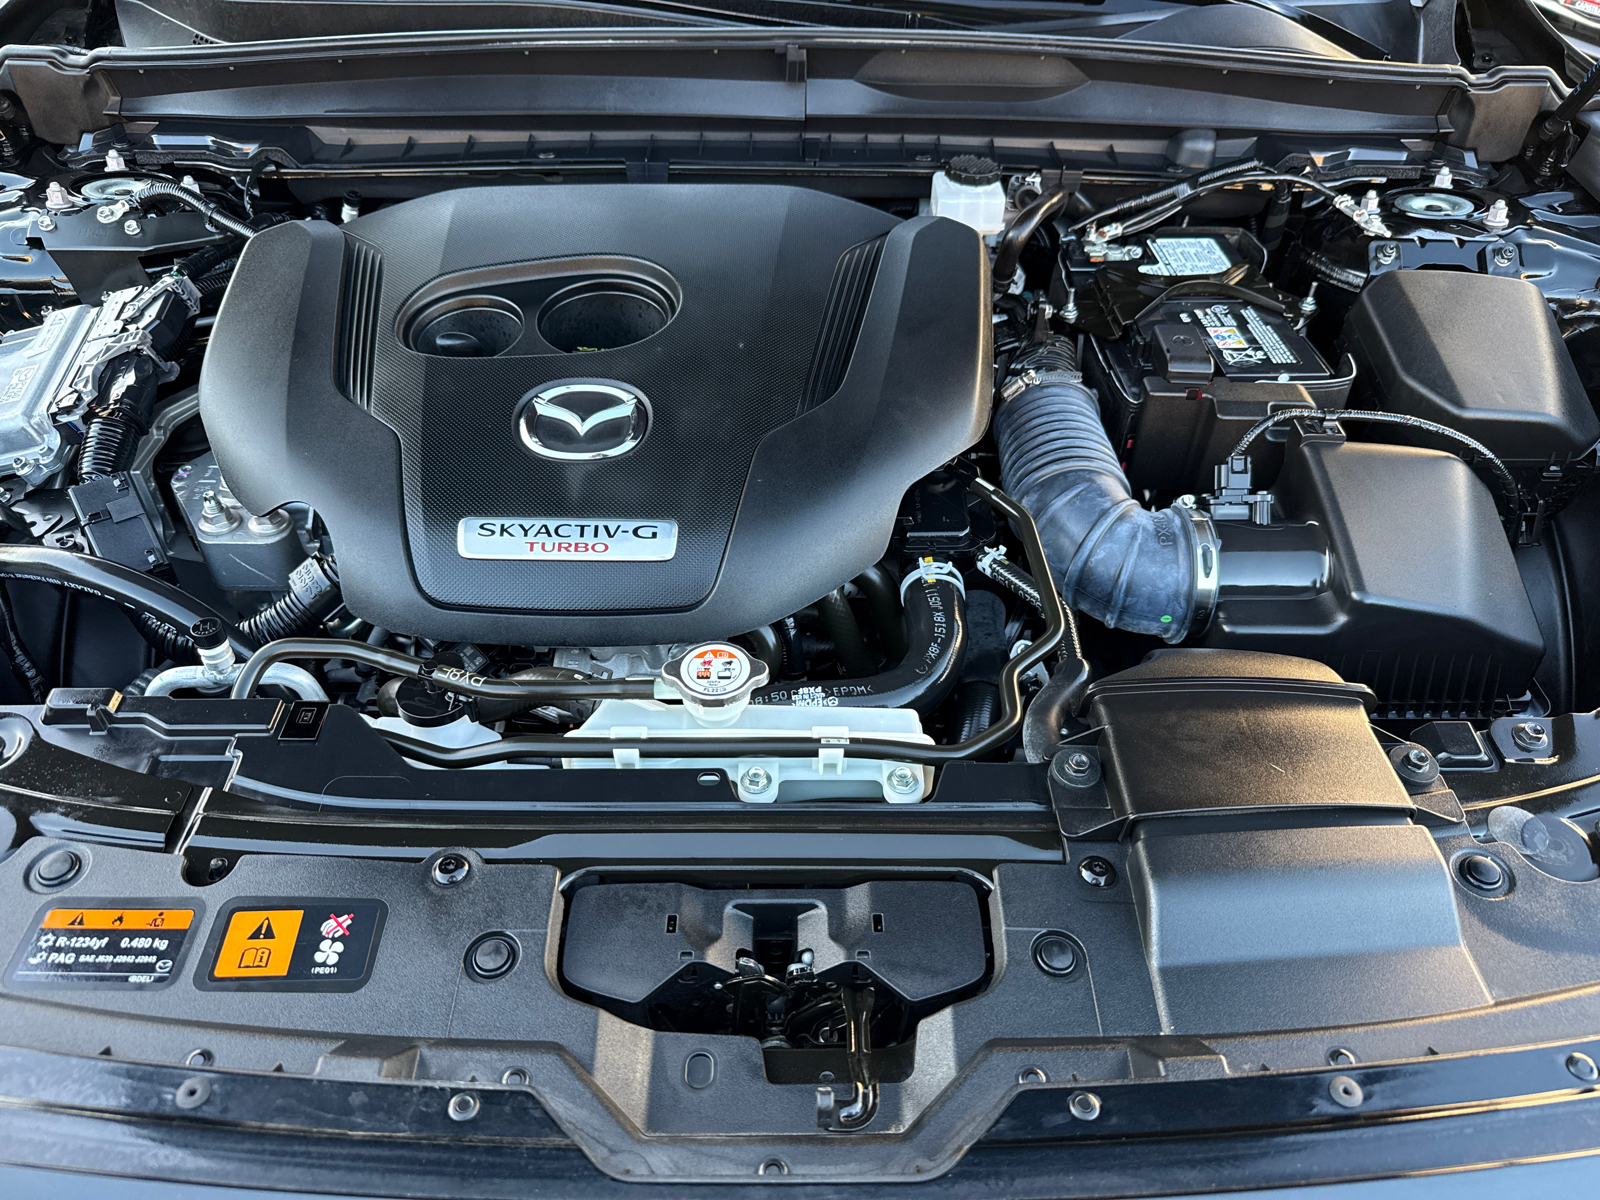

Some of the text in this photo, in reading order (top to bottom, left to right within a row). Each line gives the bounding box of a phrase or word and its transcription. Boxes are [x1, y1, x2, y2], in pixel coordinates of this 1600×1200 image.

[477, 522, 659, 539] SKYACTIV-G
[524, 541, 609, 554] TURBO
[55, 936, 170, 950] R-1234yf 0.480 kg
[47, 953, 76, 964] PAG
[78, 954, 95, 963] SAE
[311, 966, 338, 975] (PE01)
